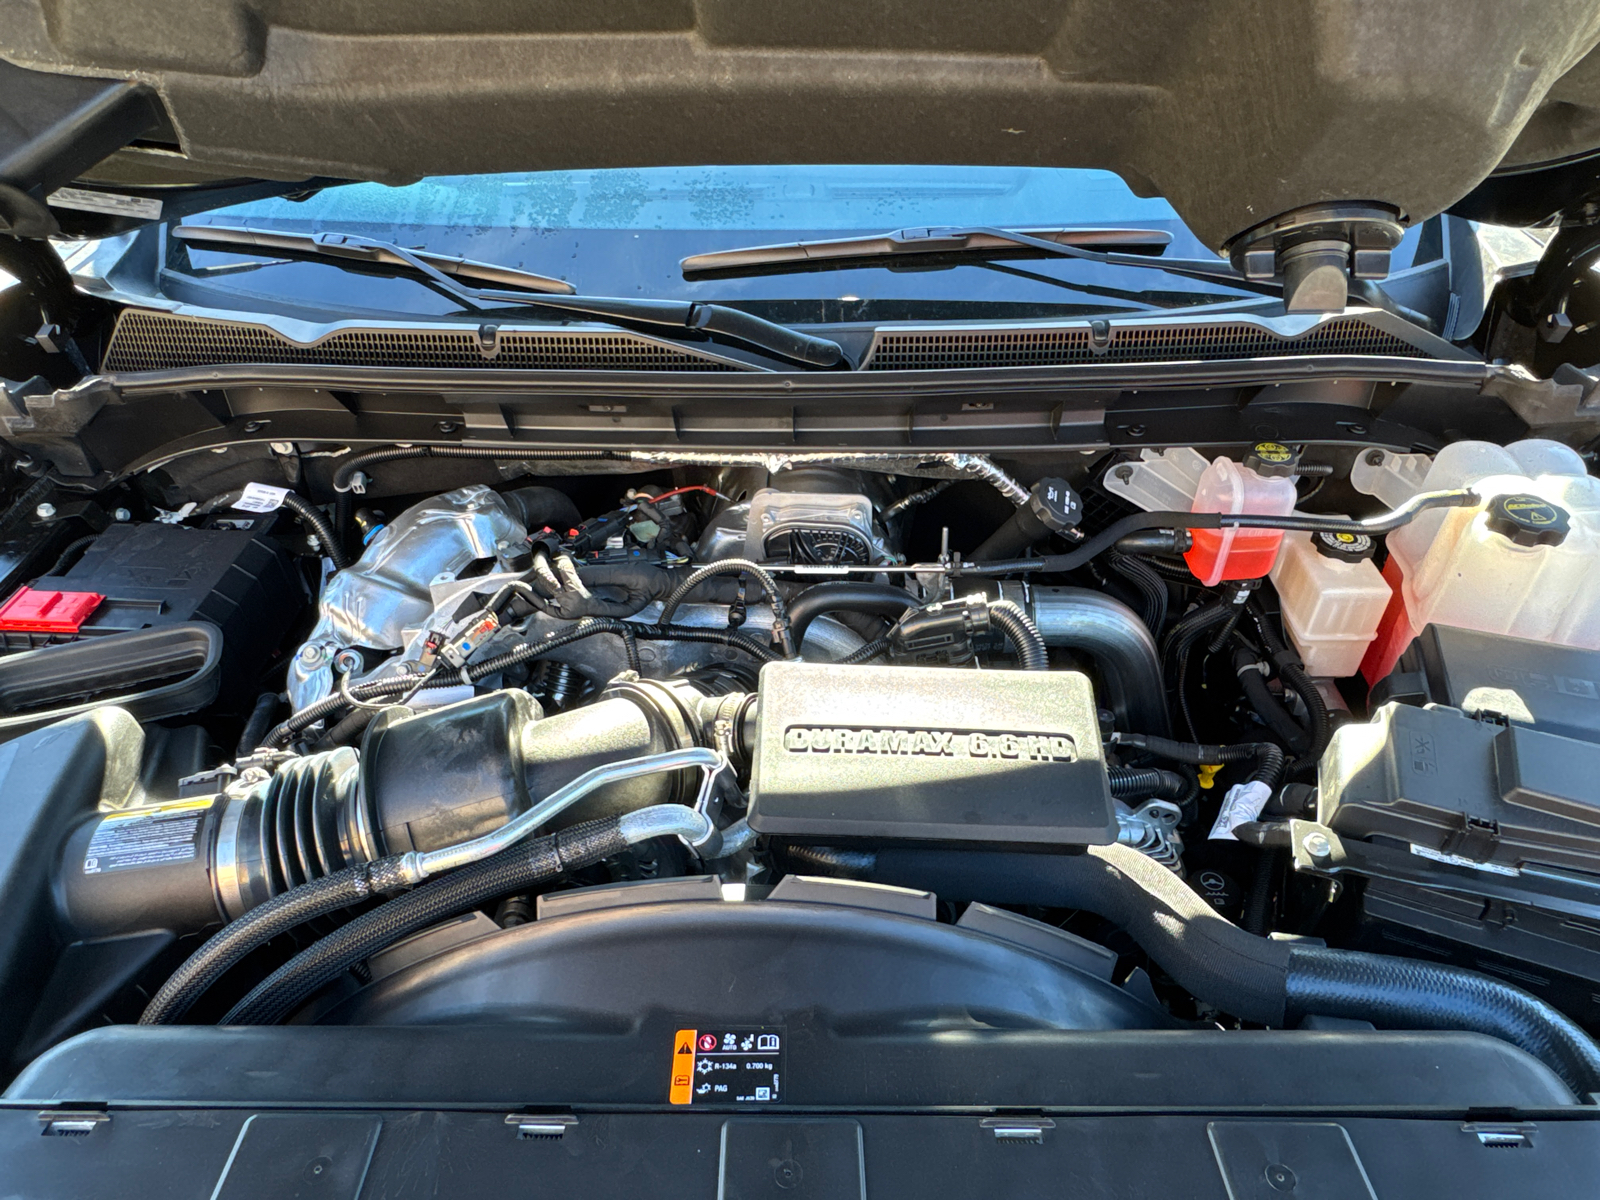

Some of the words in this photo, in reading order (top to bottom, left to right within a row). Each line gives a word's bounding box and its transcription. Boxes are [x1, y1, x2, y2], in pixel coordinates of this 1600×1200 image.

[788, 728, 954, 756] DURAMAX
[968, 732, 1020, 759] 6.6
[1027, 735, 1075, 762] HD
[714, 1062, 737, 1070] R-134a
[746, 1062, 764, 1070] 0.700
[764, 1062, 773, 1070] kg
[714, 1084, 728, 1092] PAG
